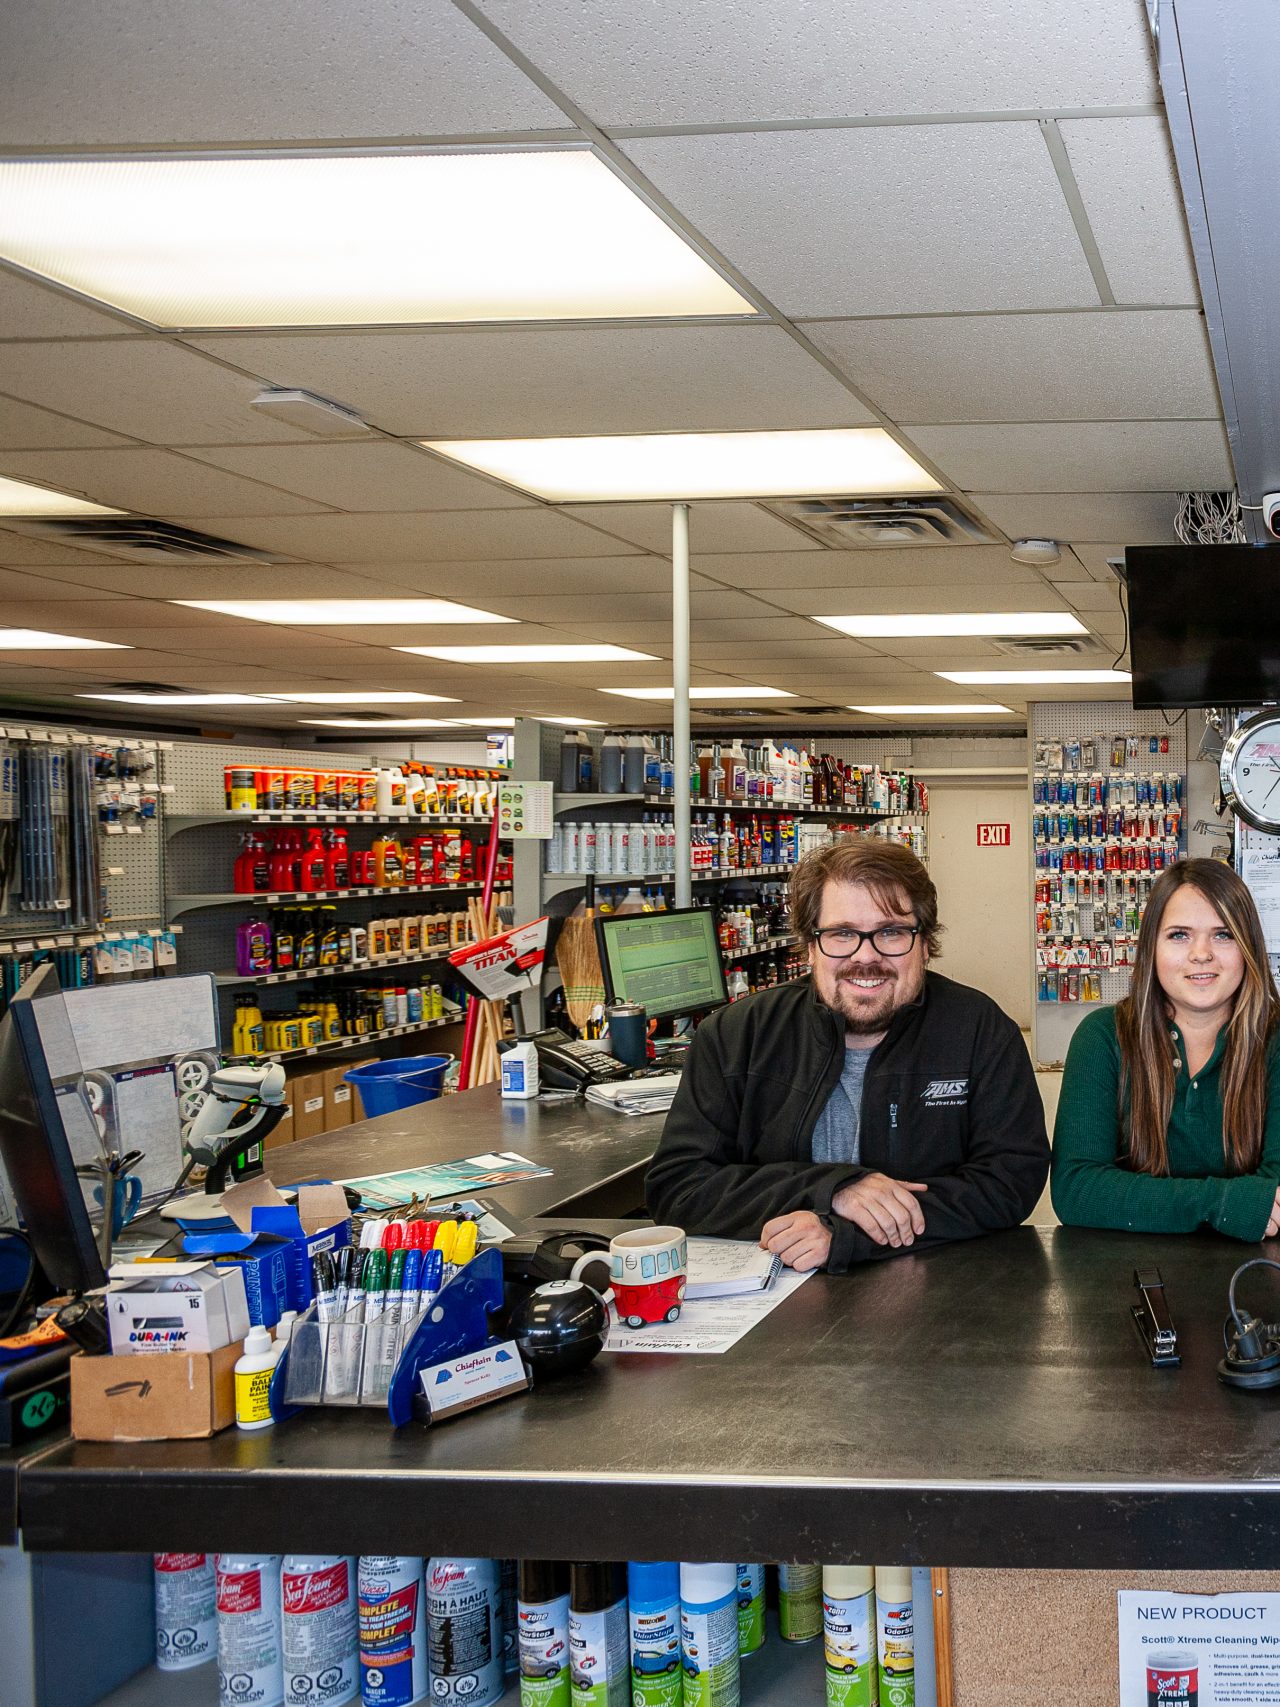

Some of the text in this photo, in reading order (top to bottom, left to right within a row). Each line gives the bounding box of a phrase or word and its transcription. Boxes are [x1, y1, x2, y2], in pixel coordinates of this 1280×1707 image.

[1242, 767, 1251, 776] 9
[980, 825, 1007, 844] EXIT
[474, 948, 518, 971] TITAN
[188, 1298, 200, 1309] 15
[129, 1331, 189, 1342] DURA-INK
[455, 1356, 492, 1373] Chieftain
[250, 1384, 270, 1393] PAIN
[285, 1581, 301, 1603] Sea
[460, 1588, 488, 1606] HAUT
[369, 1604, 408, 1623] TREATMENT
[1137, 1607, 1267, 1620] NEW PRODUCT
[360, 1625, 397, 1641] COMPLET
[886, 1627, 913, 1635] OdorSt
[1177, 1636, 1212, 1644] Xtreme
[1214, 1636, 1258, 1645] Cleaning
[1157, 1676, 1176, 1690] Scott
[231, 1689, 265, 1701] POISON
[286, 1679, 353, 1702] DANGER POISON
[365, 1687, 386, 1695] DANGER
[453, 1686, 489, 1702] POISON
[1158, 1689, 1188, 1700] XTREME
